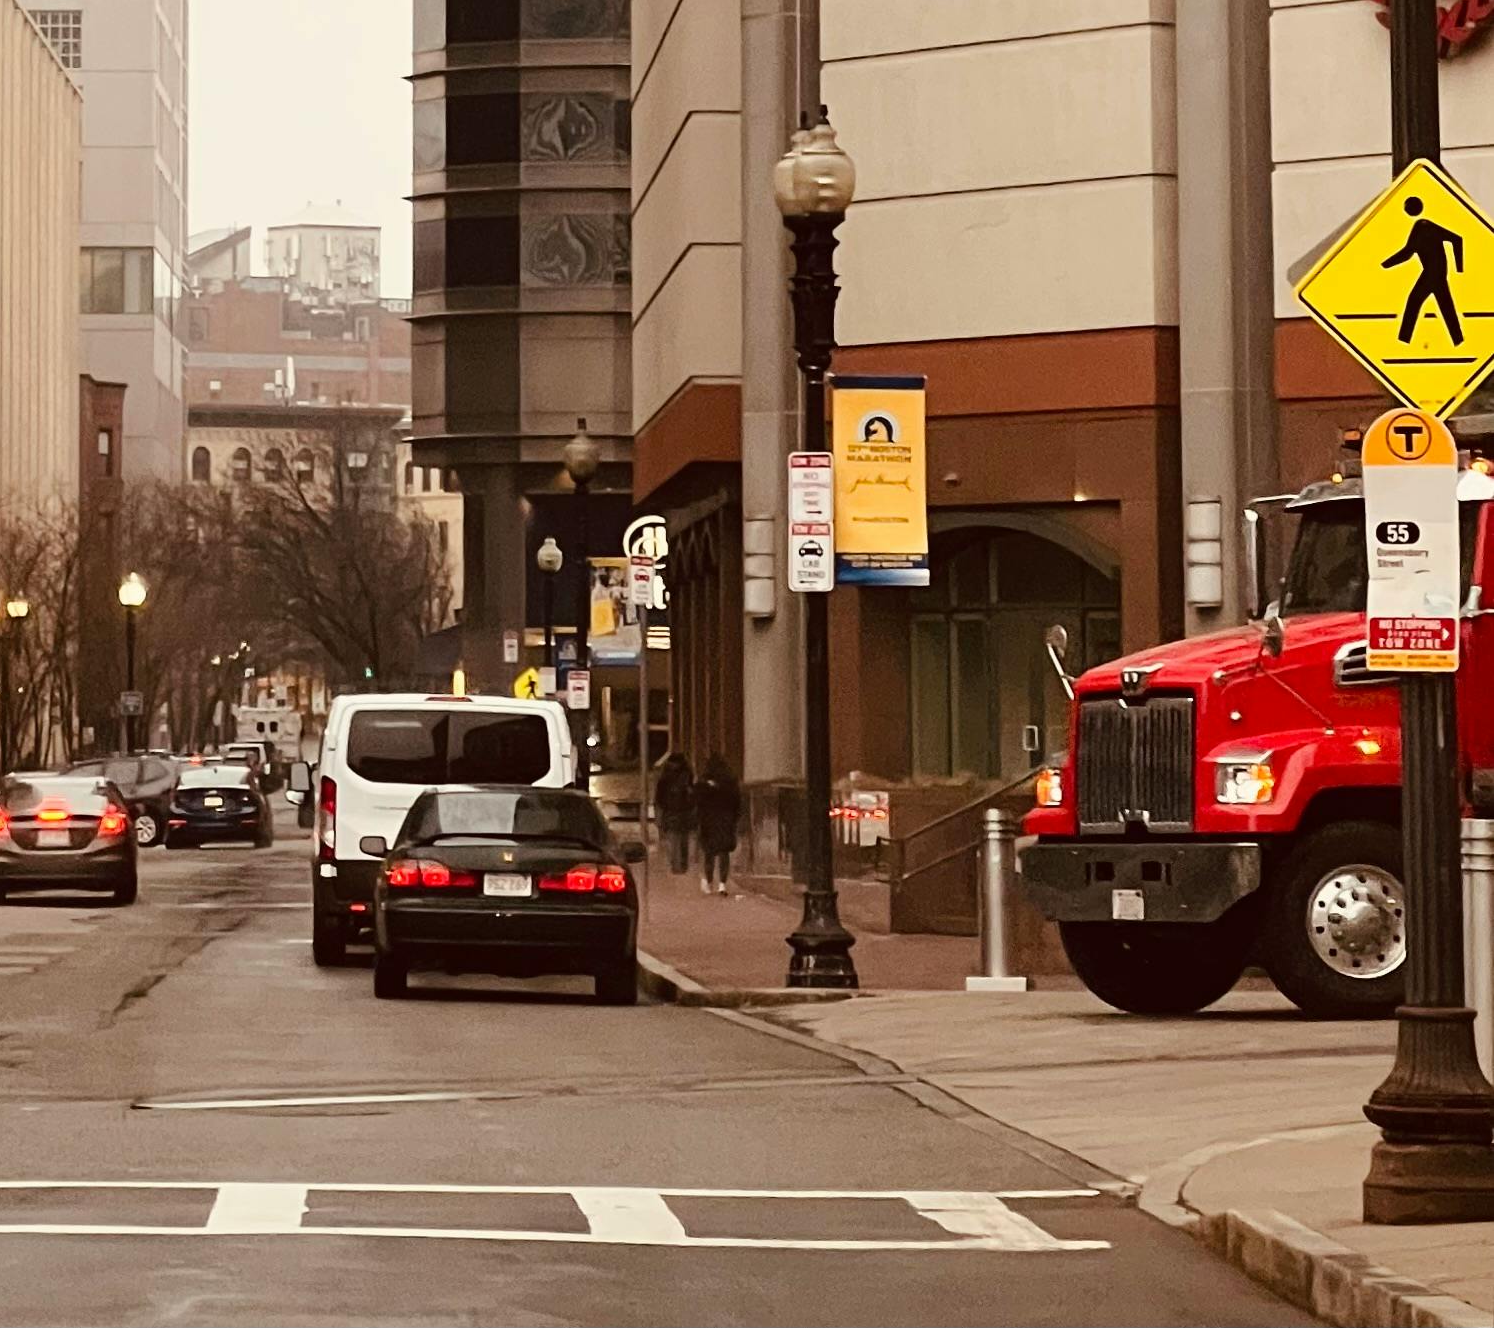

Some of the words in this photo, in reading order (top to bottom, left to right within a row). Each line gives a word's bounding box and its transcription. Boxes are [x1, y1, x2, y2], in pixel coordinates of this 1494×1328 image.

[1393, 426, 1424, 453] T
[1386, 524, 1410, 543] 55
[1378, 638, 1405, 649] TOW
[1409, 638, 1443, 649] ZONE
